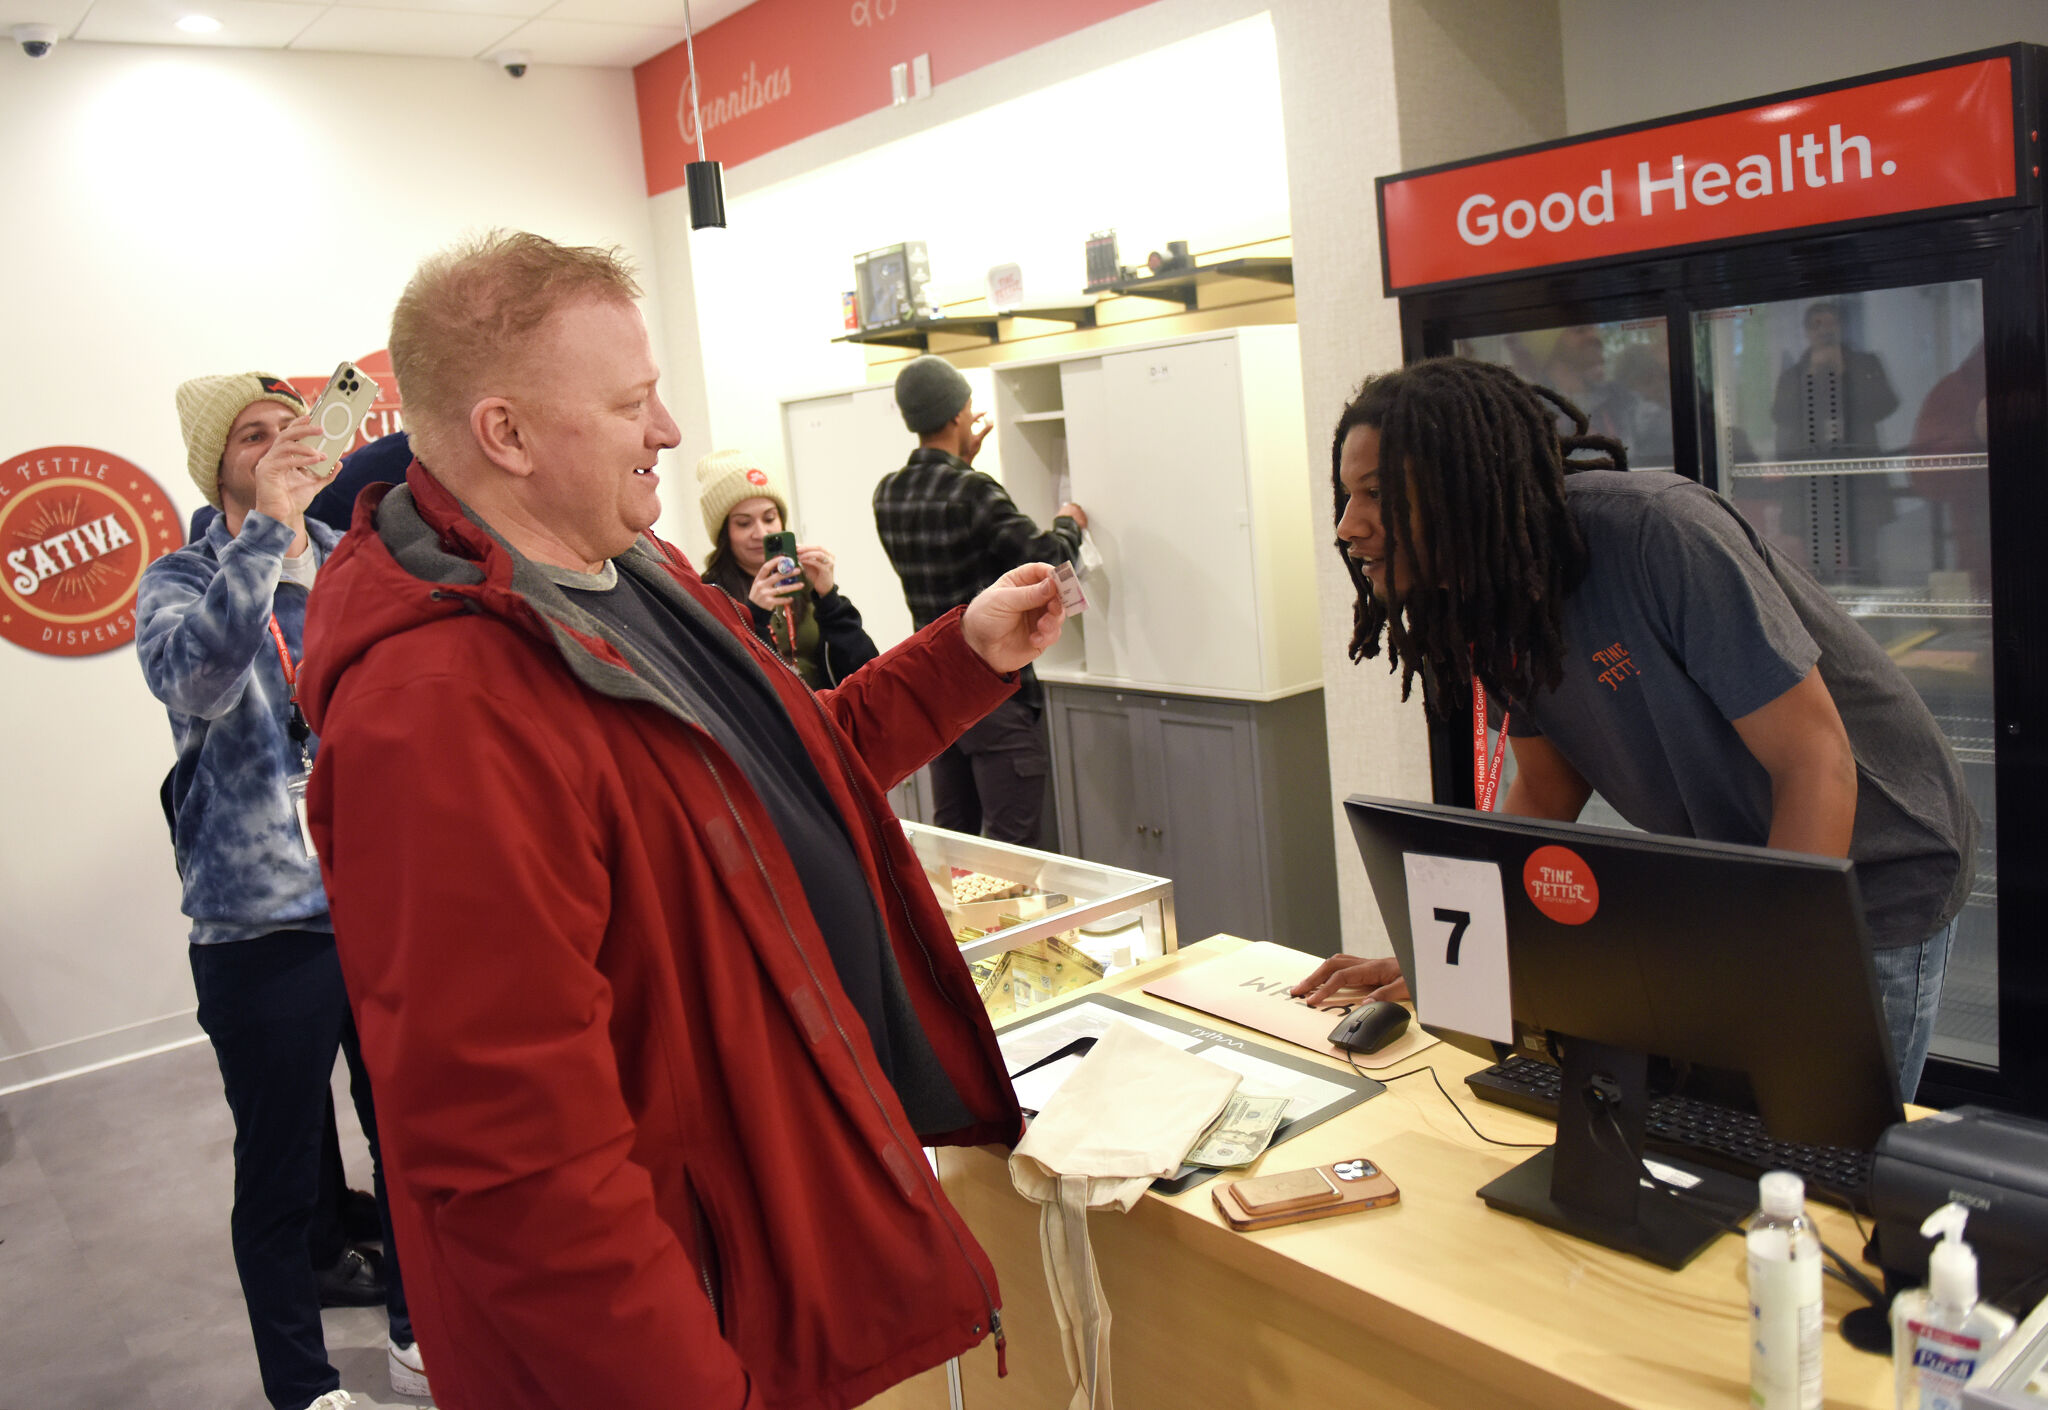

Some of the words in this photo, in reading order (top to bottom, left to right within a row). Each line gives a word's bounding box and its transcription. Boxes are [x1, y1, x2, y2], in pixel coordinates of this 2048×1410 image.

[678, 61, 790, 144] Cannibas
[1456, 169, 1615, 246] Good
[1637, 123, 1898, 217] Health.
[17, 457, 109, 480] FETTLE
[7, 513, 133, 595] SATIVA
[42, 608, 136, 645] DISPENS
[1592, 643, 1629, 667] FINE
[1598, 658, 1641, 691] FETT
[1476, 677, 1484, 711] Conditi
[1476, 712, 1485, 736] Good
[1489, 756, 1501, 780] Good
[1481, 780, 1496, 812] Conditi
[1539, 866, 1574, 884] FINE
[1531, 880, 1591, 903] FETTLE
[1433, 907, 1471, 966] 7
